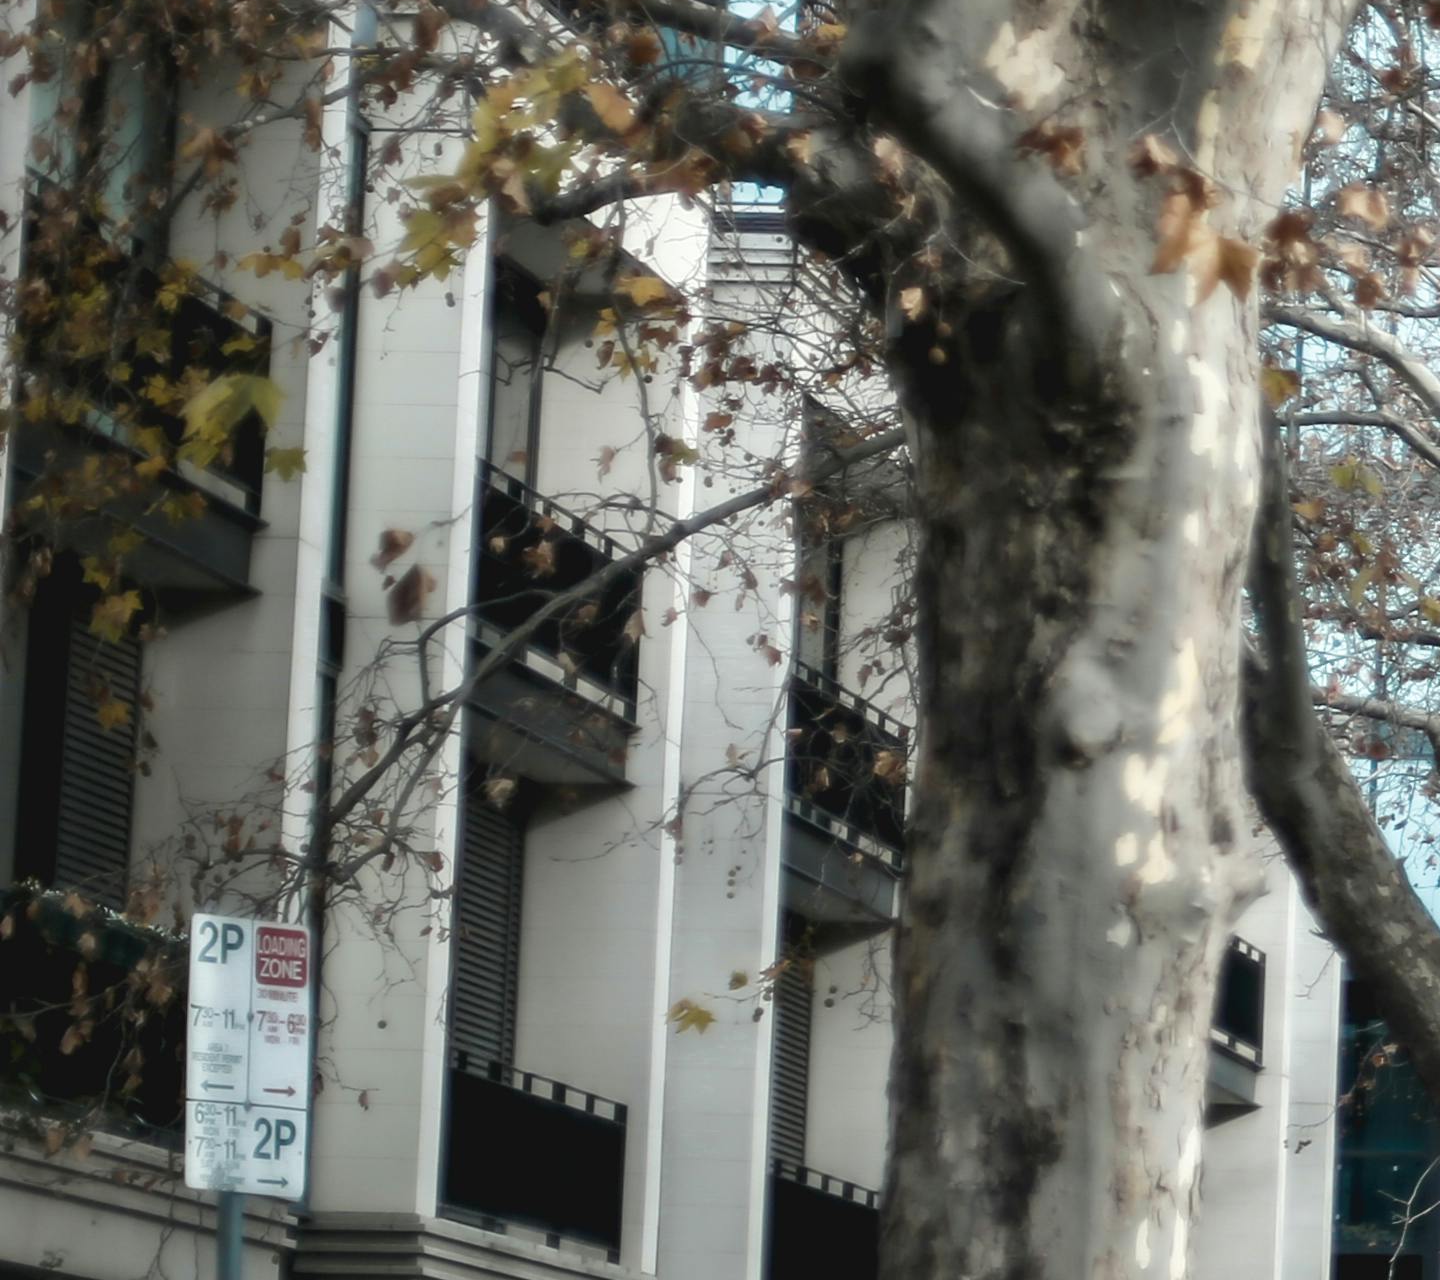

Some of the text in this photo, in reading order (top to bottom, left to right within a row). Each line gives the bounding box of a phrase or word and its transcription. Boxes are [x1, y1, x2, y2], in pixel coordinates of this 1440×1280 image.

[198, 921, 244, 964] 2P
[257, 935, 306, 958] LOADING
[260, 957, 303, 980] ZONE
[253, 1117, 296, 1160] 2P
